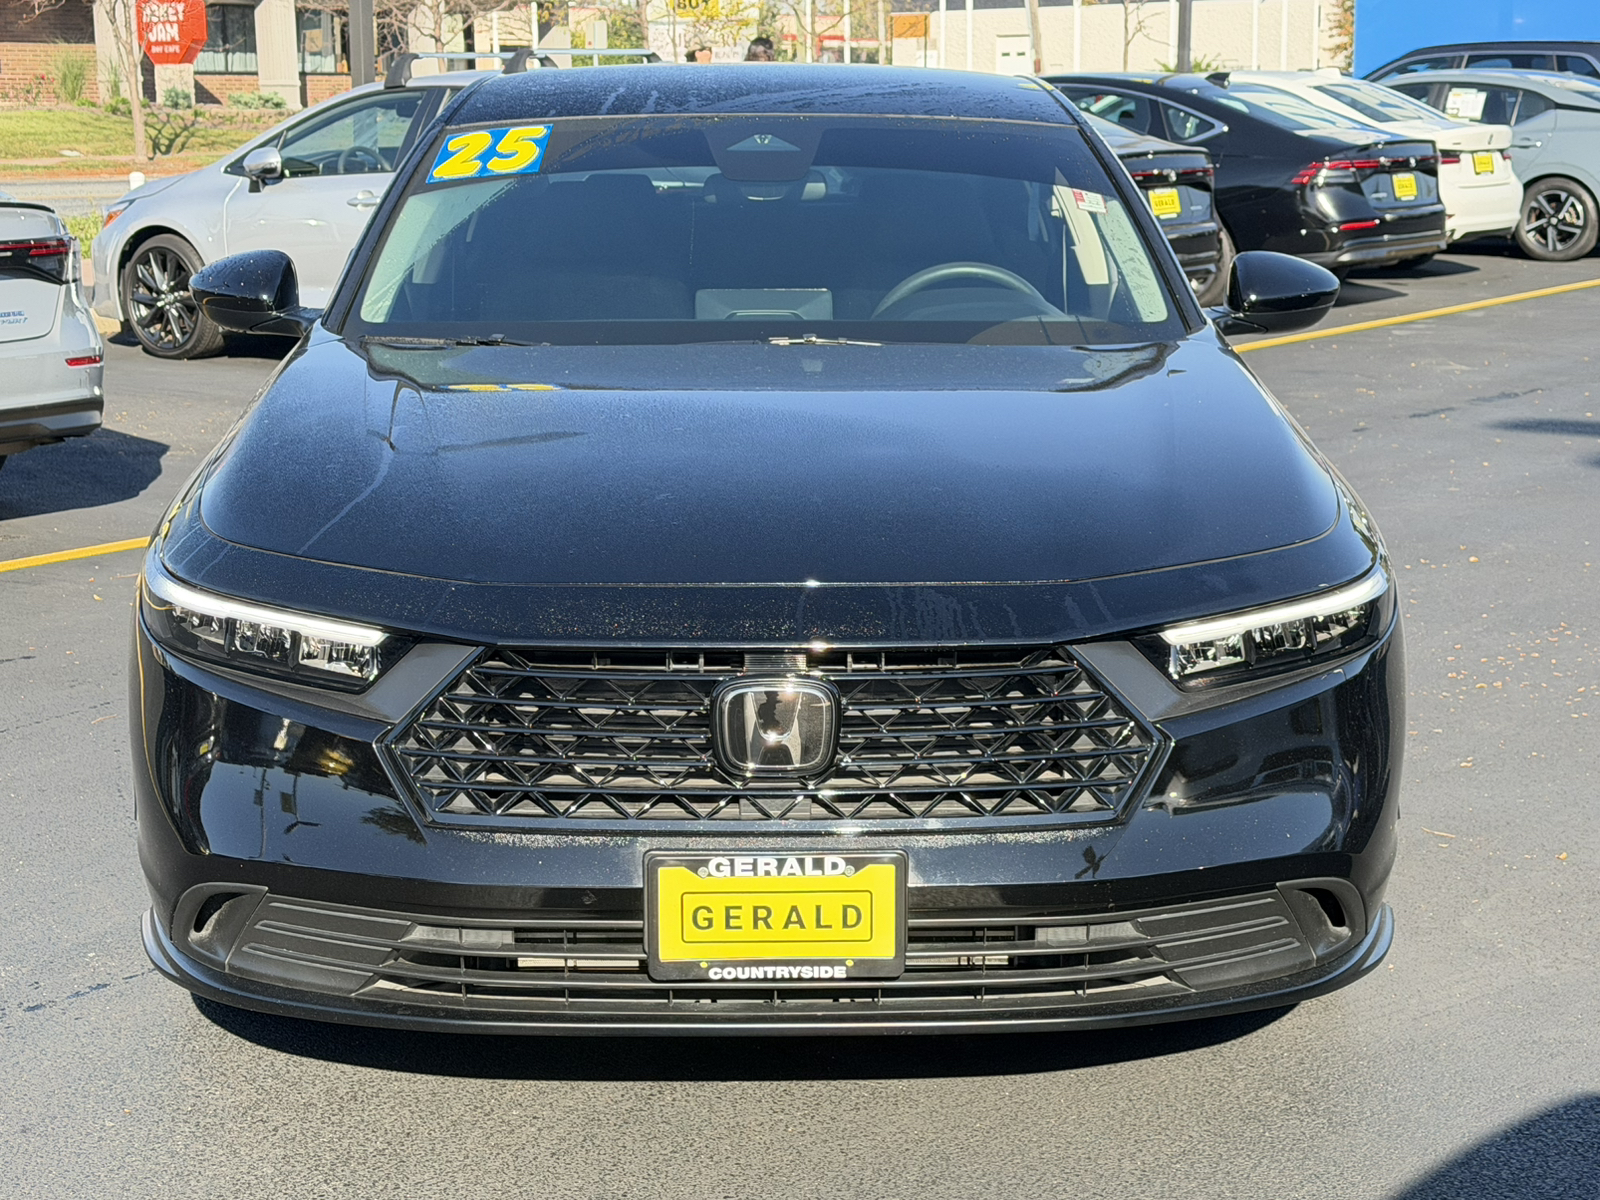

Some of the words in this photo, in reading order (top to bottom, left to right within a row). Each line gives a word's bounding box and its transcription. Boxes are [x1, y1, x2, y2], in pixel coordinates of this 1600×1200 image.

[148, 22, 180, 42] JAM
[433, 126, 549, 178] 25
[708, 857, 846, 877] GERALD
[691, 904, 863, 931] GERALD
[708, 965, 847, 980] COUNTRYSIDE
